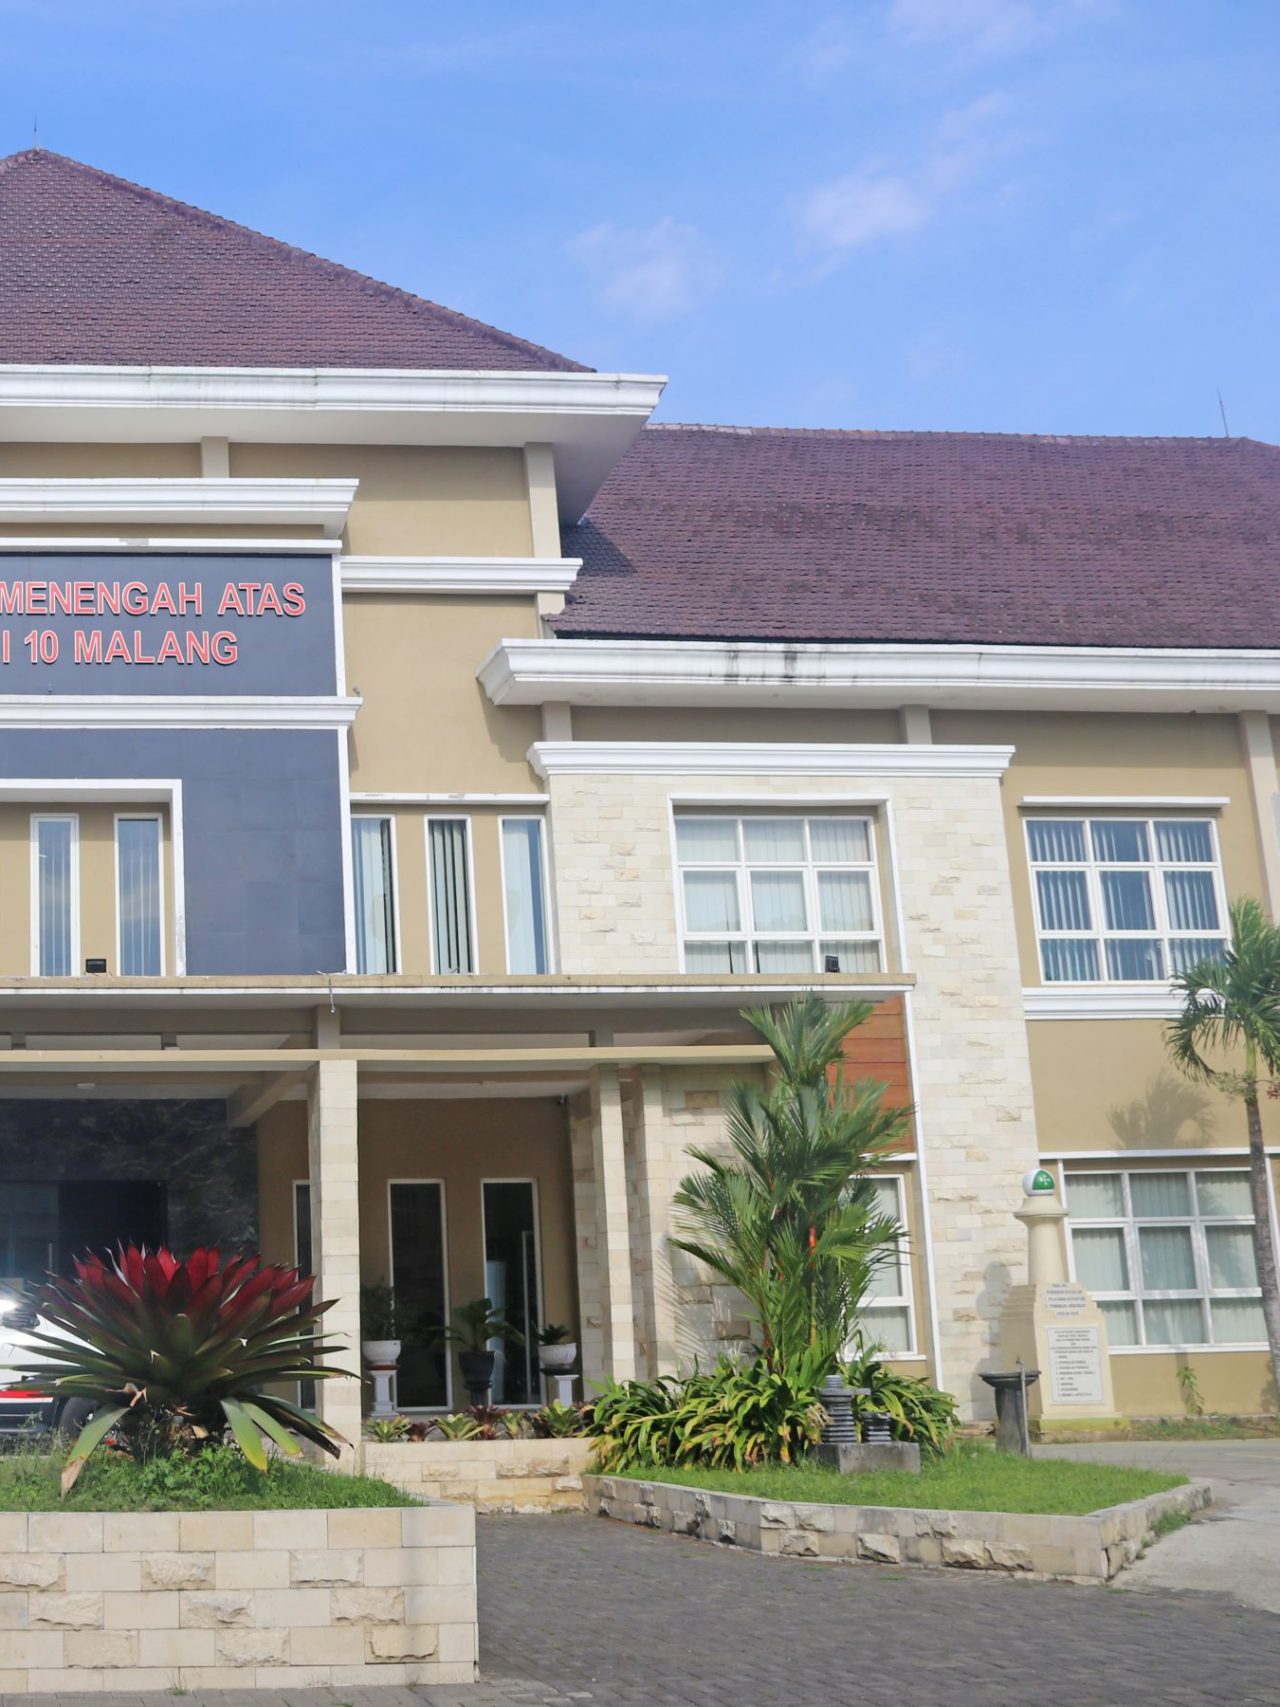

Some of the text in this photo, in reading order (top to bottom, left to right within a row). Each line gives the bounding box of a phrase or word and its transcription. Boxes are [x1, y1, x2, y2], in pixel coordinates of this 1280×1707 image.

[218, 581, 306, 617] ATAS
[24, 629, 59, 664] 10
[73, 629, 238, 665] MALANG
